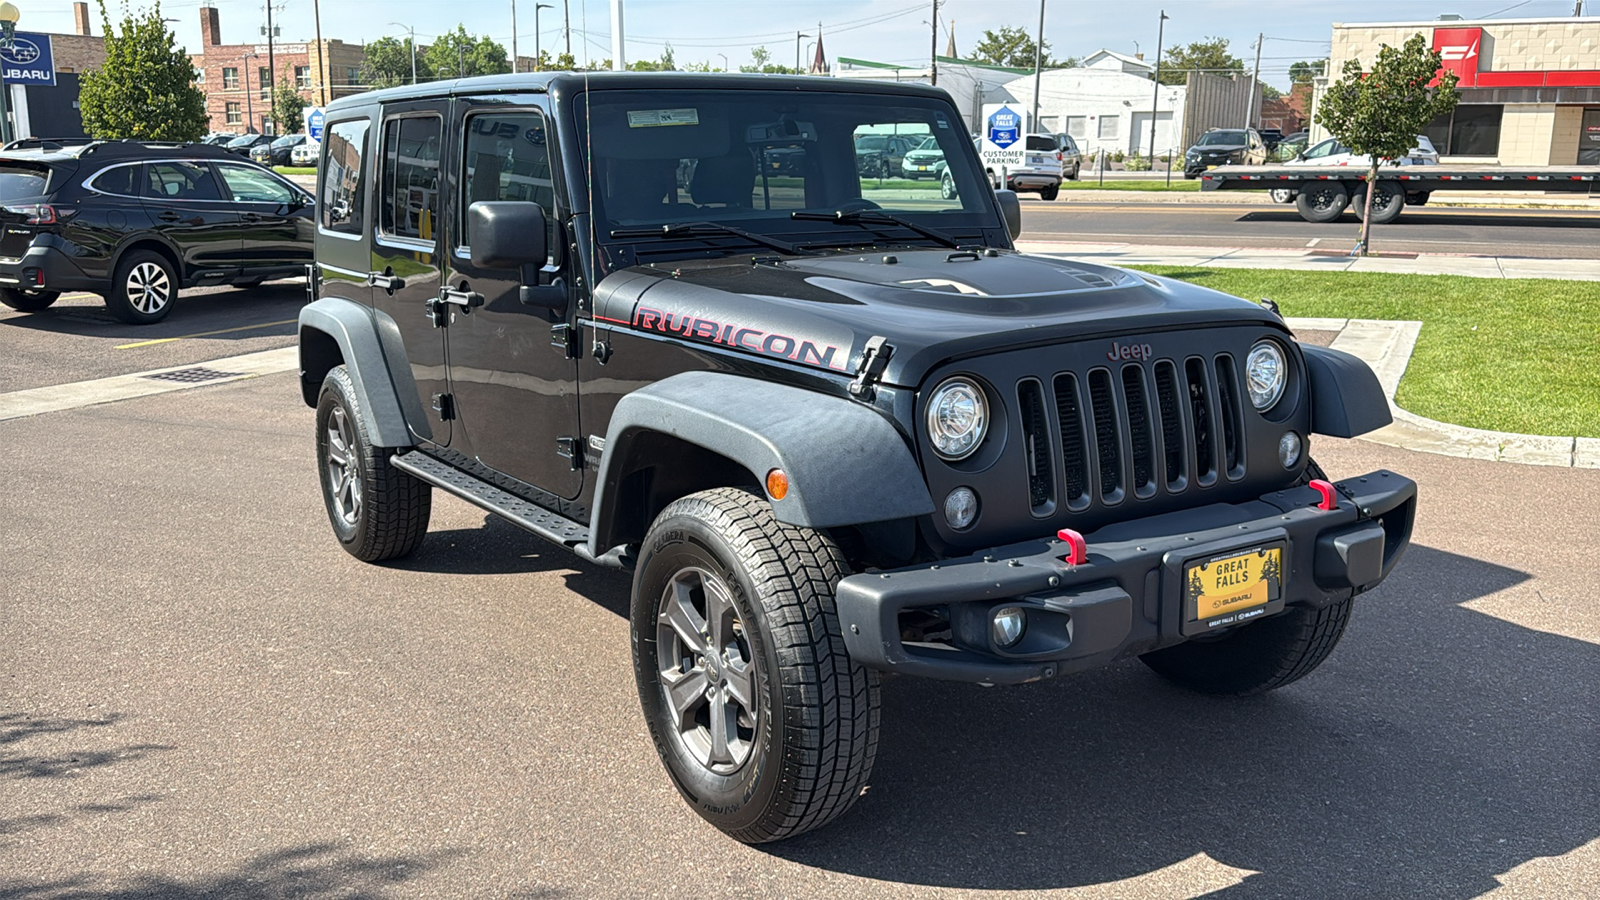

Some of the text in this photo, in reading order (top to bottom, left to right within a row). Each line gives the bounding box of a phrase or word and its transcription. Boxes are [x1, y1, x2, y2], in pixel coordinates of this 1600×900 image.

[1, 68, 51, 81] UBARU
[634, 306, 848, 371] RUBICON
[1106, 341, 1153, 362] Jeep
[1216, 558, 1250, 576] GREAT
[1216, 570, 1249, 589] FALLS
[1222, 594, 1252, 605] SUBARU
[1208, 619, 1222, 627] GREAT
[1244, 609, 1264, 618] SUBARU
